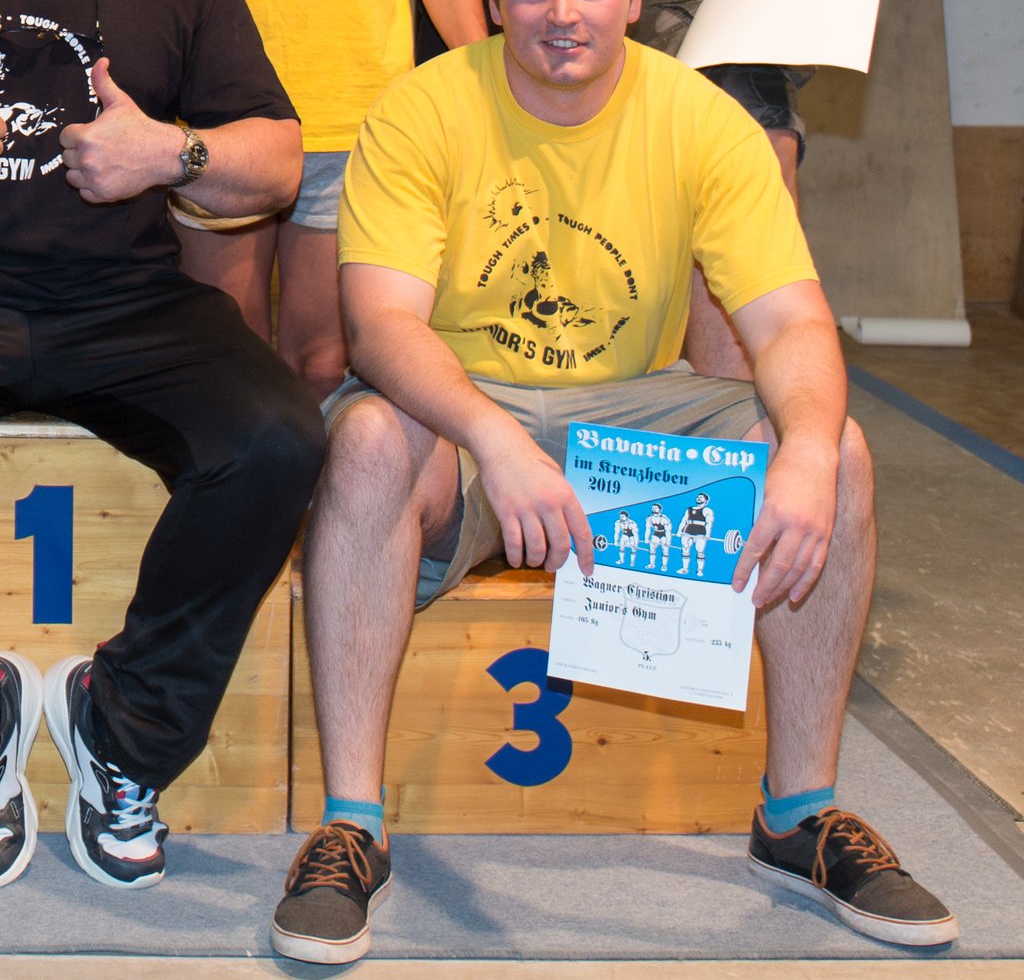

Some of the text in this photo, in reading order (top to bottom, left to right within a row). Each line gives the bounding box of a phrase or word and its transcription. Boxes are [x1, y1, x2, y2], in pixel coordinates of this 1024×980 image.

[20, 14, 59, 31] TOUGH
[59, 28, 91, 65] PEOPLE
[40, 154, 64, 176] IMST
[477, 250, 503, 289] TOUGH
[502, 222, 530, 249] TIMES
[557, 213, 593, 235] TOUGH
[594, 232, 627, 267] PEOPLE
[542, 346, 577, 369] GYM
[582, 315, 630, 363] IMST TIROL
[576, 428, 755, 472] Bavaria Cup
[574, 455, 689, 485] im Kreuzheben
[588, 475, 621, 494] 2019
[15, 485, 73, 624] 1
[582, 576, 675, 603] Wagner Christian
[632, 605, 657, 621] Gym
[484, 647, 573, 786] 3
